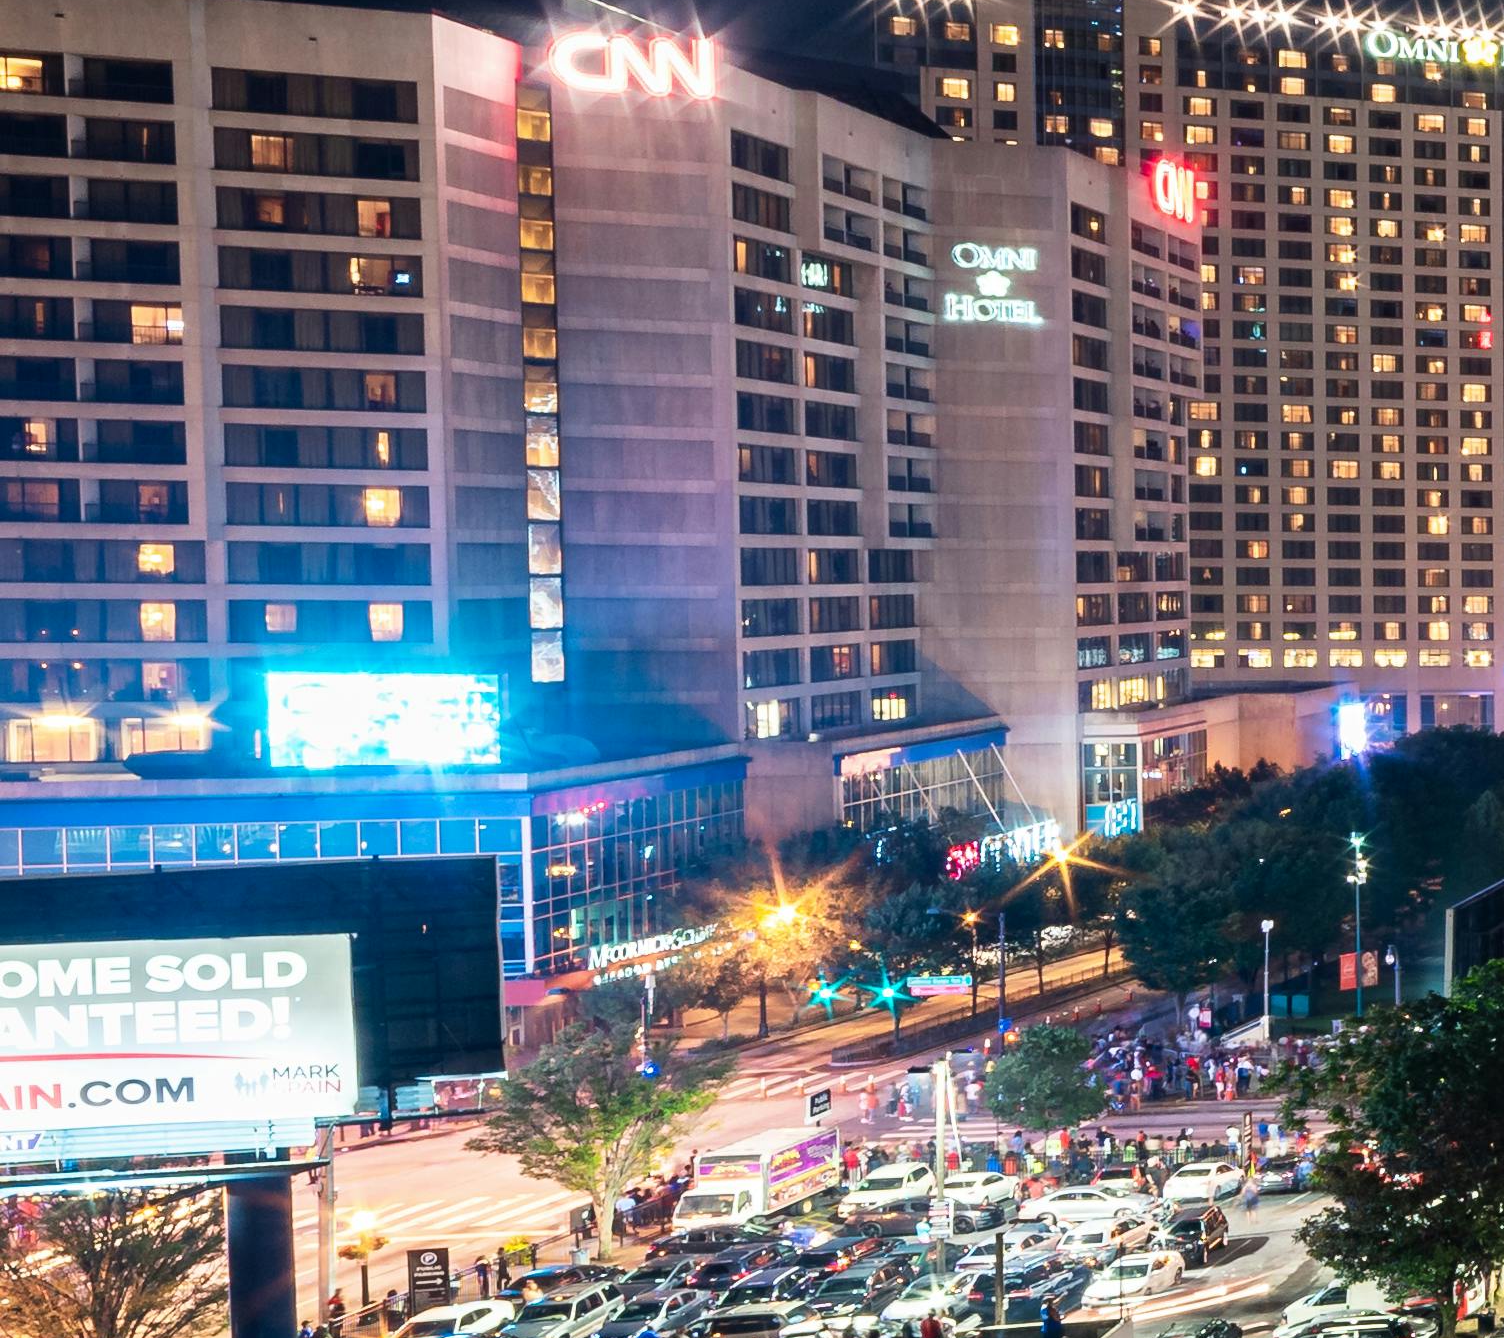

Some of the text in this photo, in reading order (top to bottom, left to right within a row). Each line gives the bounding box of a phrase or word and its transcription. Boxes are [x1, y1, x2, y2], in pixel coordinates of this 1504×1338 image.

[1366, 29, 1460, 63] OMNI
[548, 29, 716, 100] CNN
[1156, 159, 1194, 223] CNN
[952, 242, 1038, 271] OMNI
[944, 293, 1044, 324] HOTEL
[145, 951, 307, 993] SOLD
[272, 1063, 340, 1080] MARK
